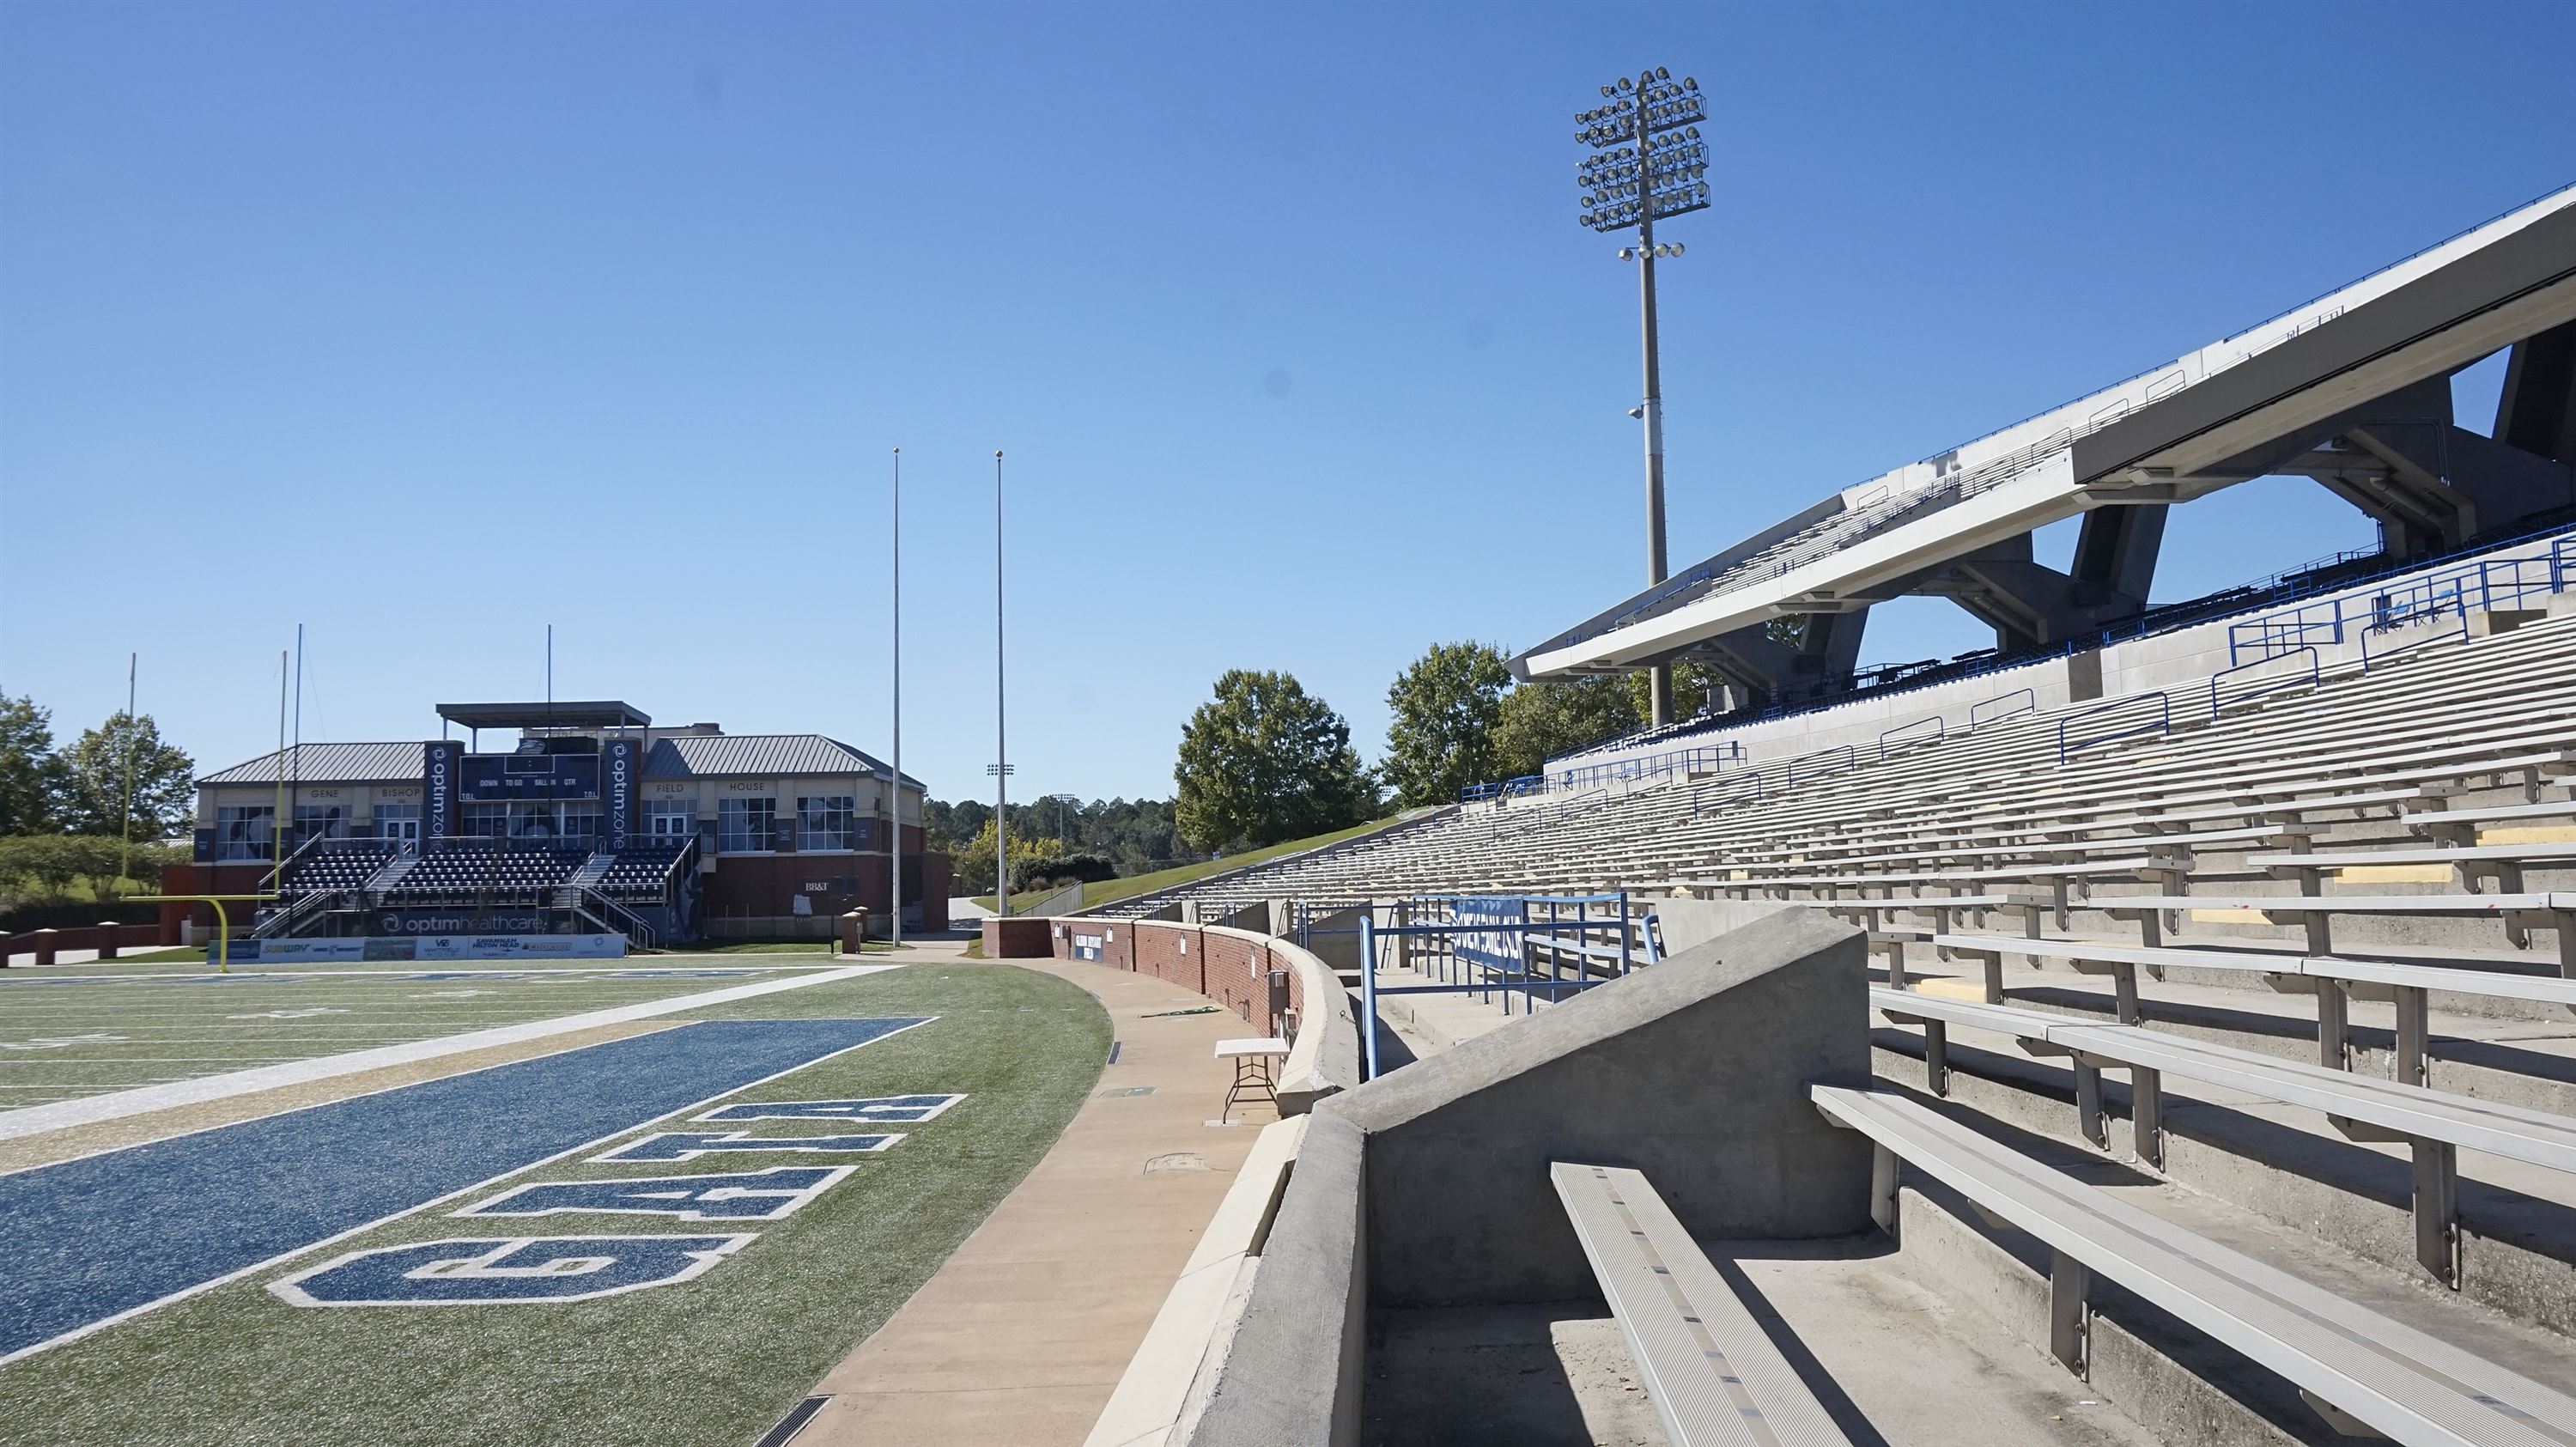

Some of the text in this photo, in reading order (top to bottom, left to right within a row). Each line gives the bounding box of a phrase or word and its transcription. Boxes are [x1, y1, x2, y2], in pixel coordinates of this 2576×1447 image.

[479, 779, 498, 787] DOWN
[534, 778, 548, 787] BALL
[656, 782, 764, 793] FIELD HOUSE
[311, 788, 421, 798] GENE BISHOP
[611, 759, 628, 849] optimzone
[805, 882, 829, 891] BB&T
[405, 915, 543, 933] optimhealthcare
[262, 944, 310, 953] SUBWAY
